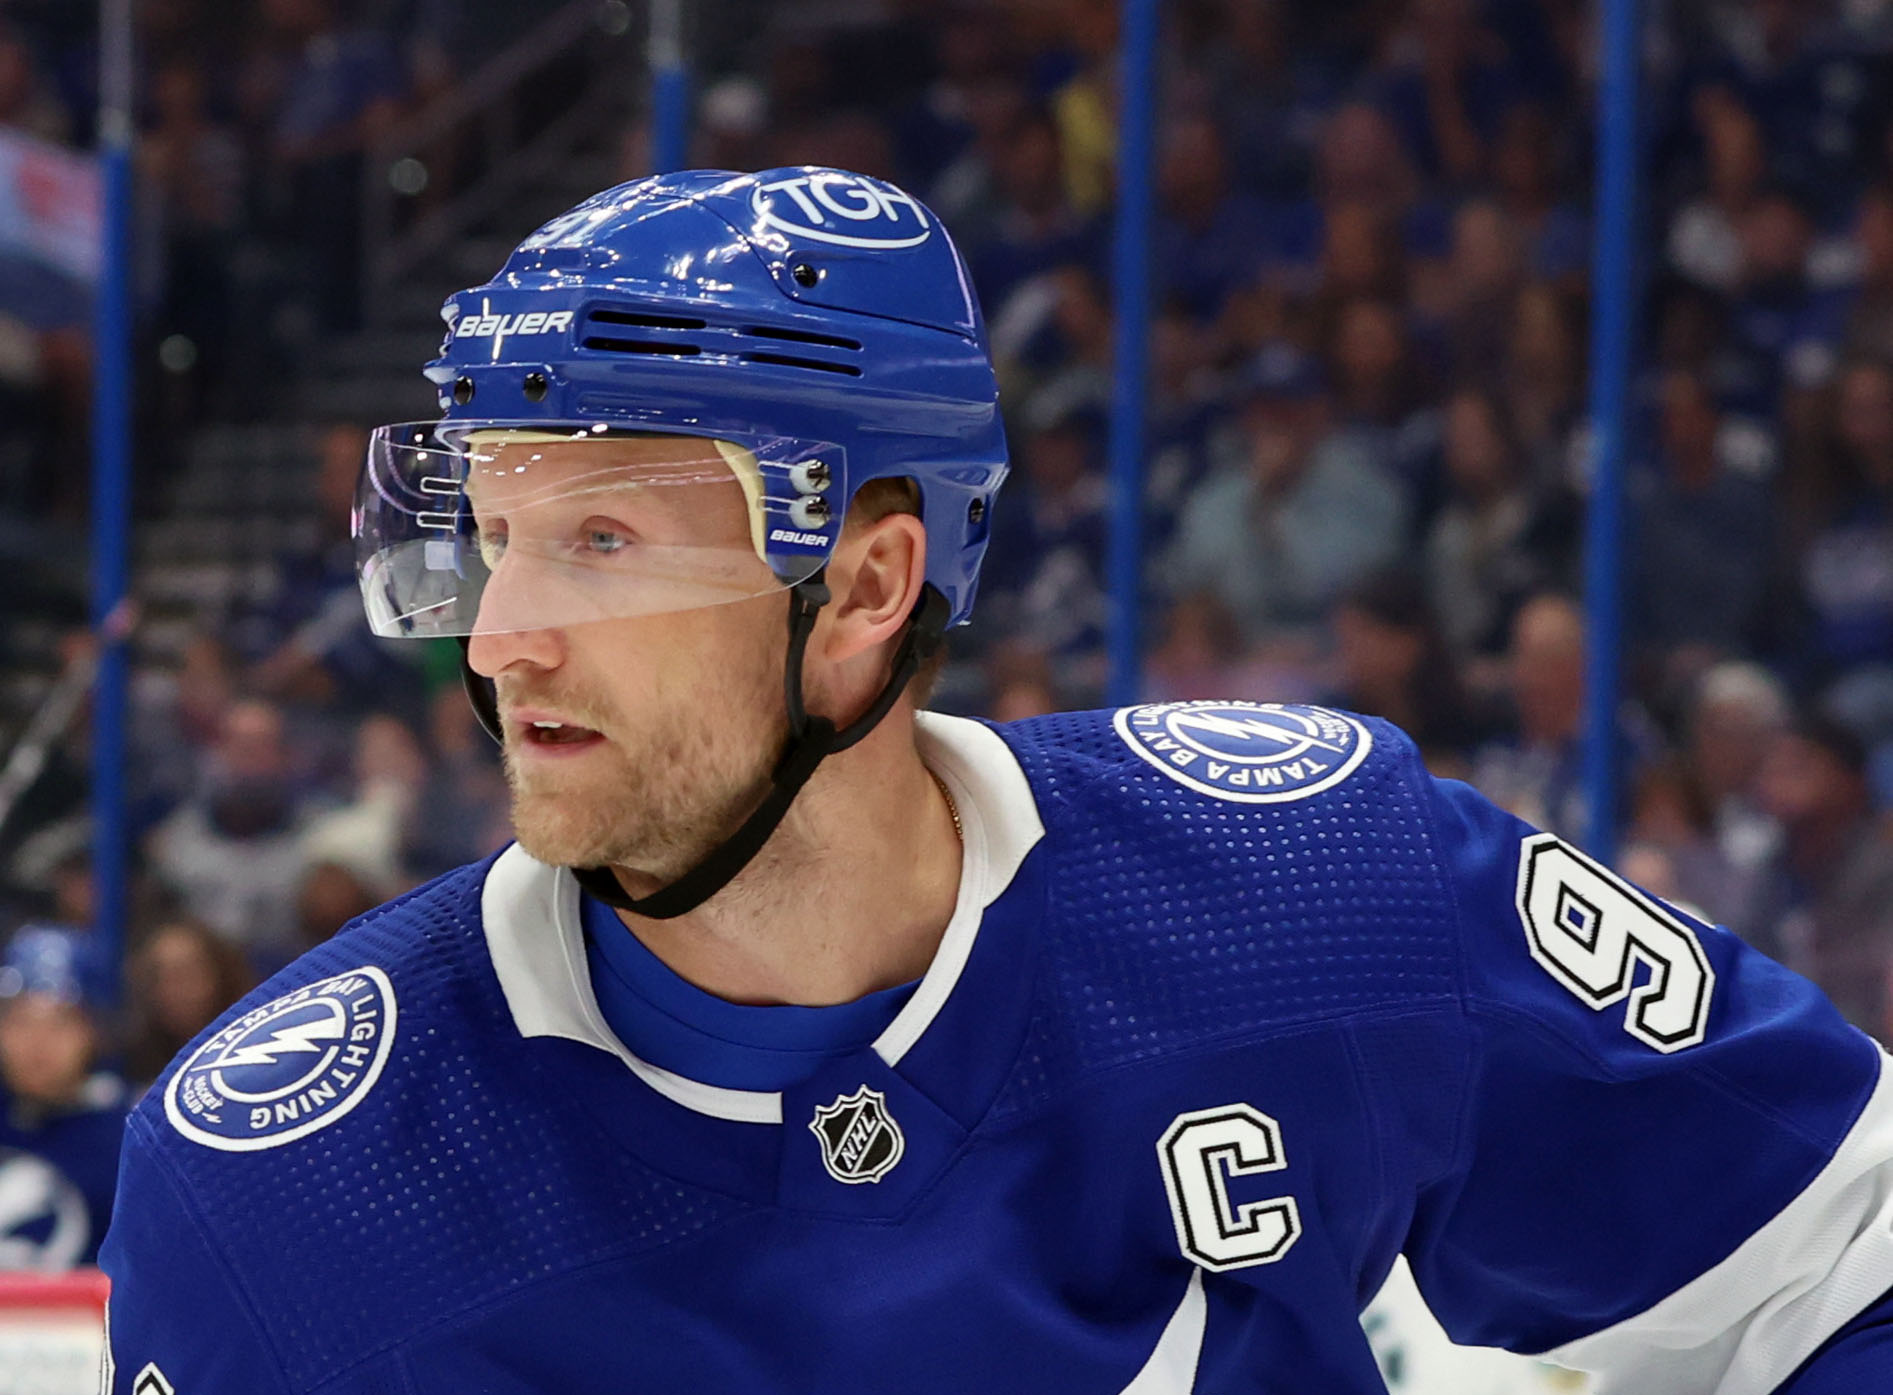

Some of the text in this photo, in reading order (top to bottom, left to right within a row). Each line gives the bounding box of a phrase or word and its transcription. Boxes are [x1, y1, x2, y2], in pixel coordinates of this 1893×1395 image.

[760, 174, 930, 229] TGH
[455, 311, 574, 338] BAUER
[769, 529, 829, 547] BAUER
[1139, 731, 1329, 787] TAMPA BAY
[204, 977, 379, 1130] TAMPA BAY LIGHTNING
[840, 1111, 878, 1170] NHL
[1156, 1103, 1302, 1272] C
